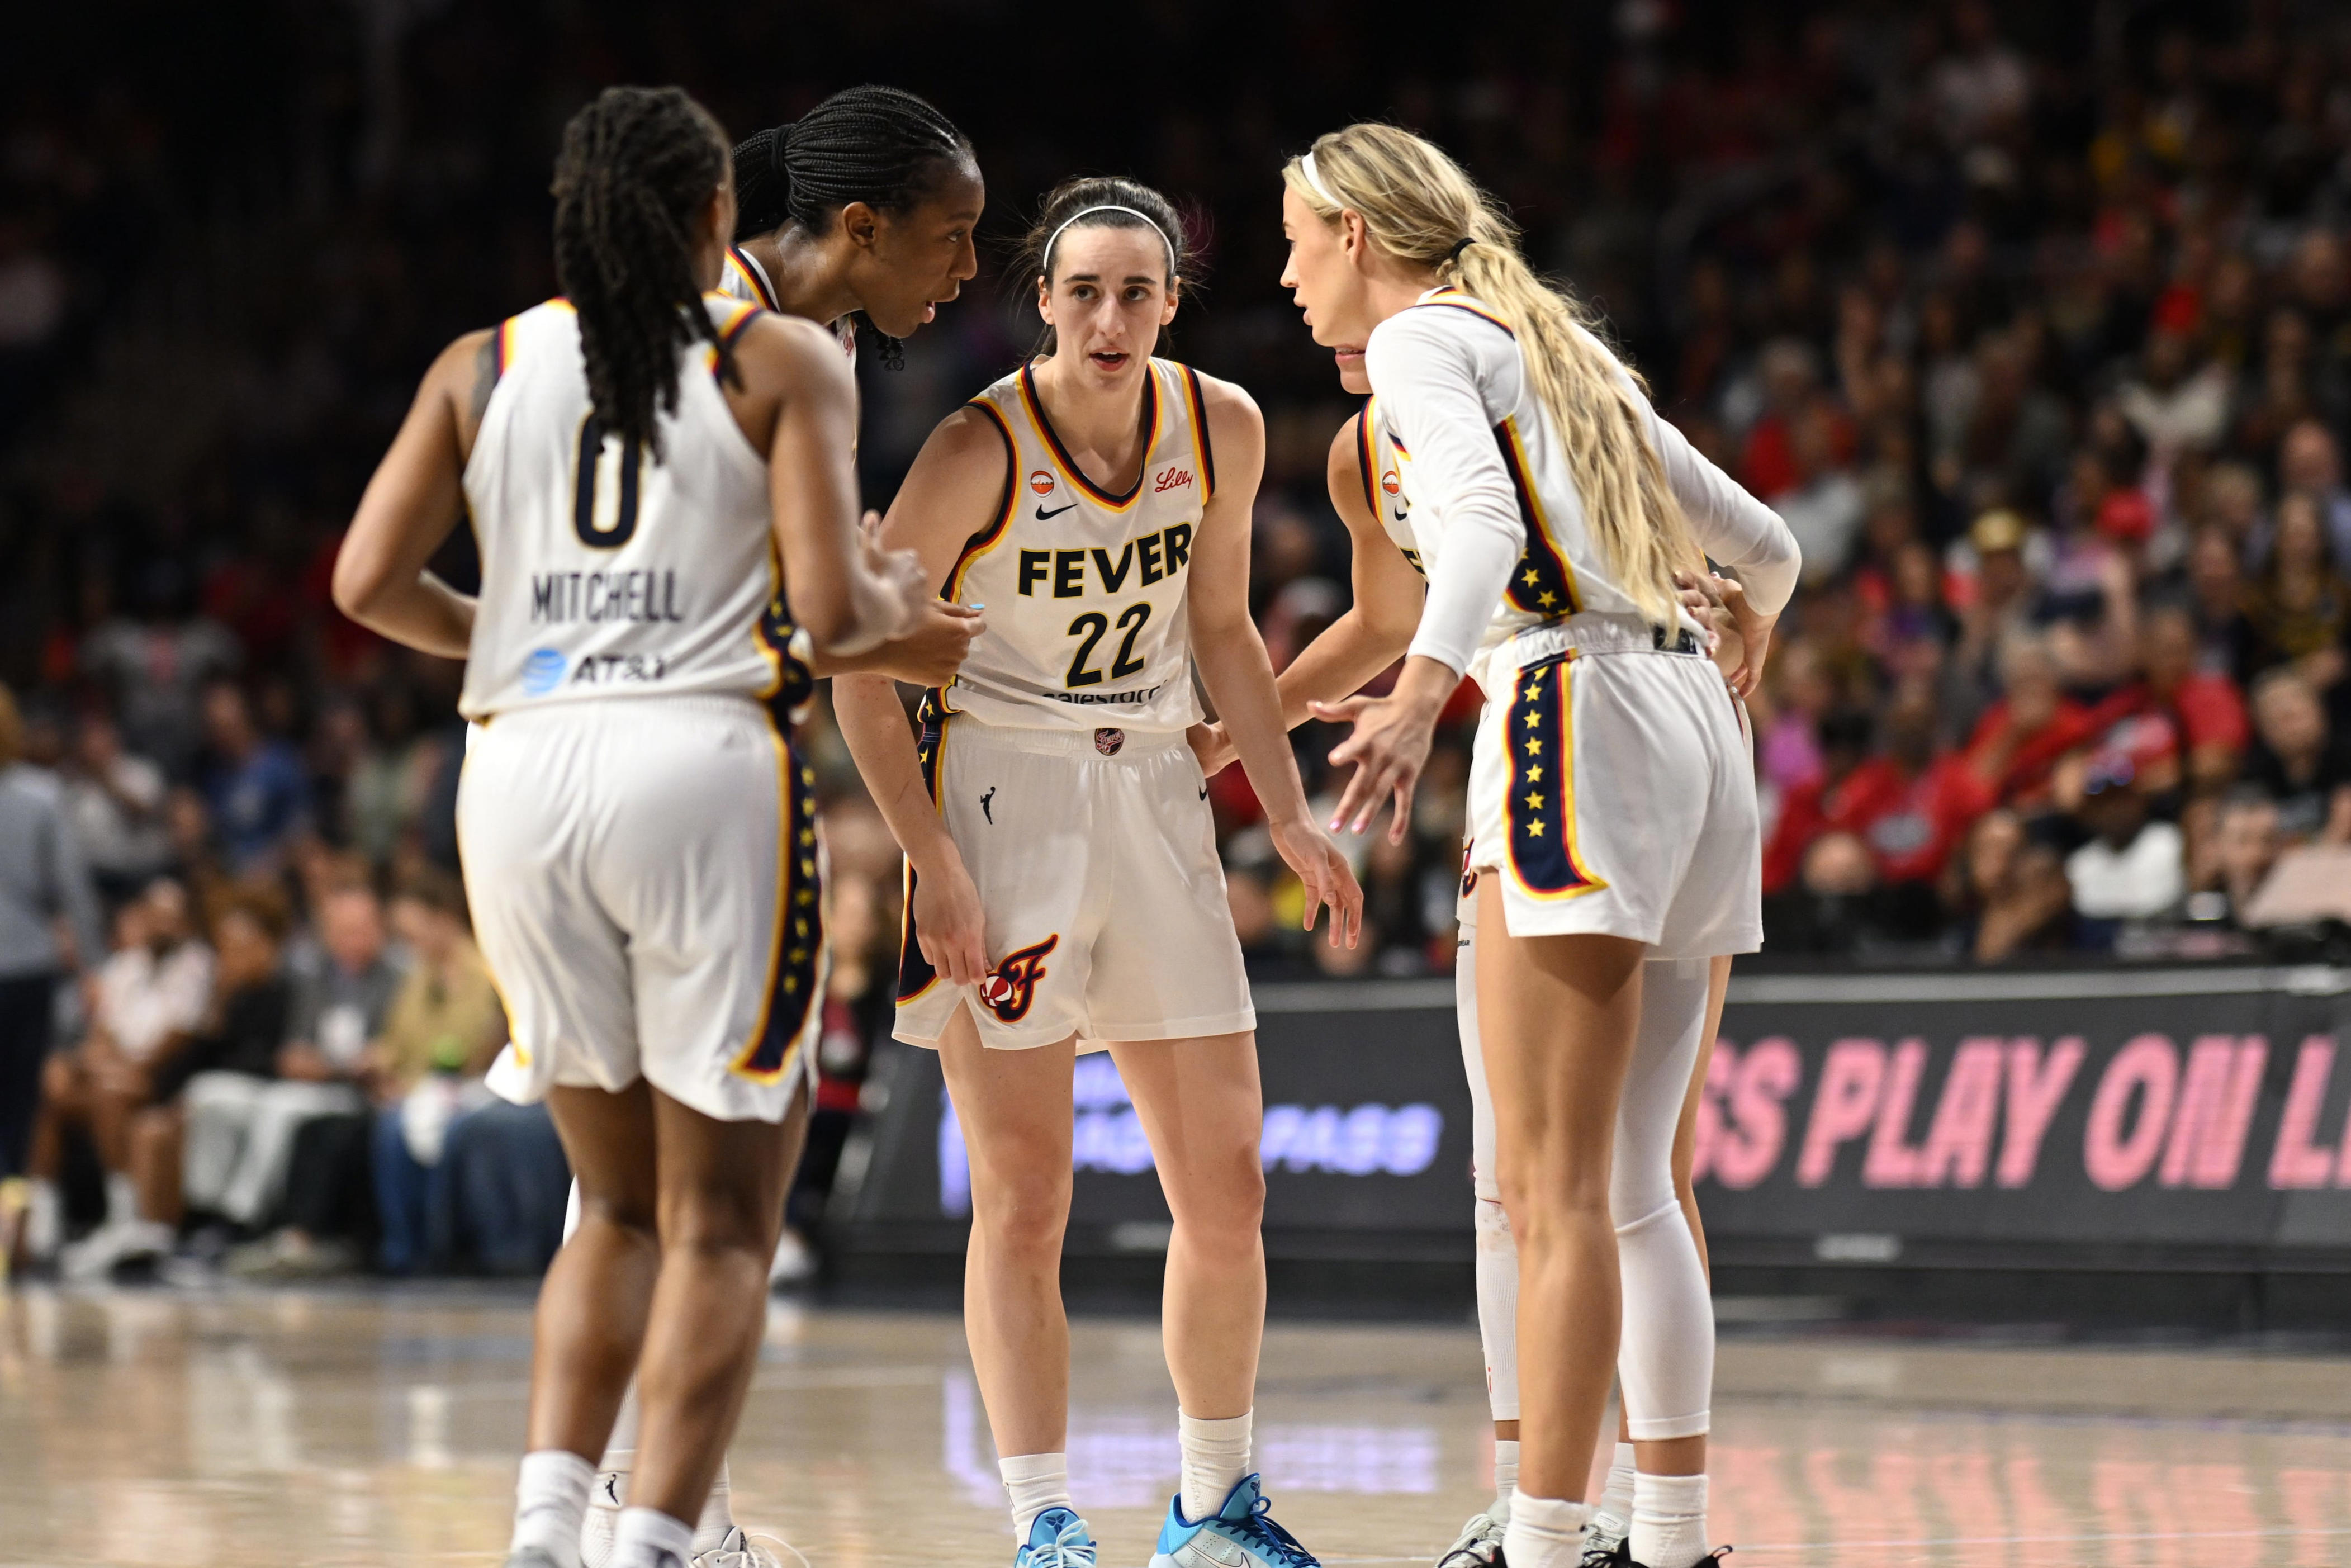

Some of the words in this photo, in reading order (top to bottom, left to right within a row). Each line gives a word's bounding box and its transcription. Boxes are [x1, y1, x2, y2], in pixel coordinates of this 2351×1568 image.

[572, 411, 642, 548] 0
[1154, 467, 1193, 492] Lilly
[531, 570, 682, 624] MITCHELL
[1017, 522, 1192, 599] FEVER
[1065, 601, 1152, 689] 22
[1794, 1035, 2088, 1189] PLAY
[2082, 1032, 2270, 1192] ON
